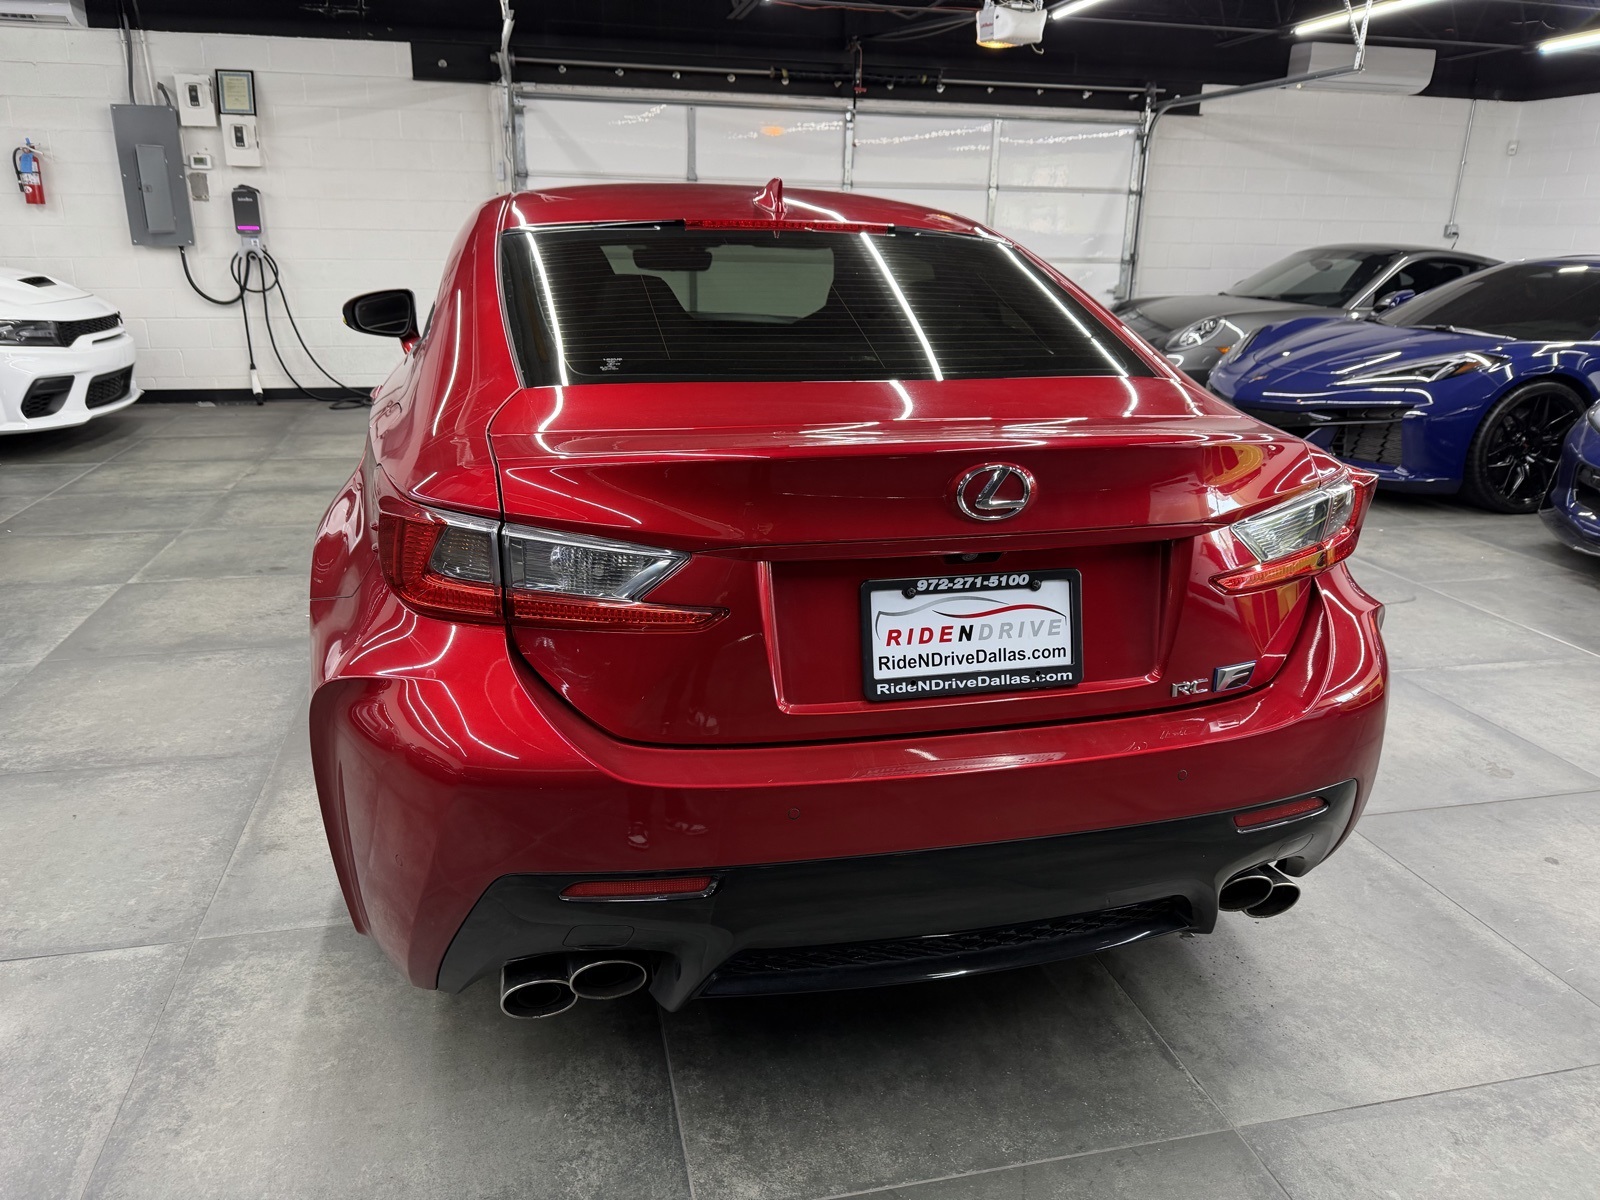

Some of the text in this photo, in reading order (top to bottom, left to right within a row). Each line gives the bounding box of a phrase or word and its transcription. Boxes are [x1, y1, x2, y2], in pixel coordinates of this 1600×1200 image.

[916, 574, 1030, 592] 972-271-5100
[878, 646, 1067, 671] RideNDriveDallas.com
[876, 671, 1073, 695] RideNDriveDallas.com
[1171, 678, 1208, 697] RC
